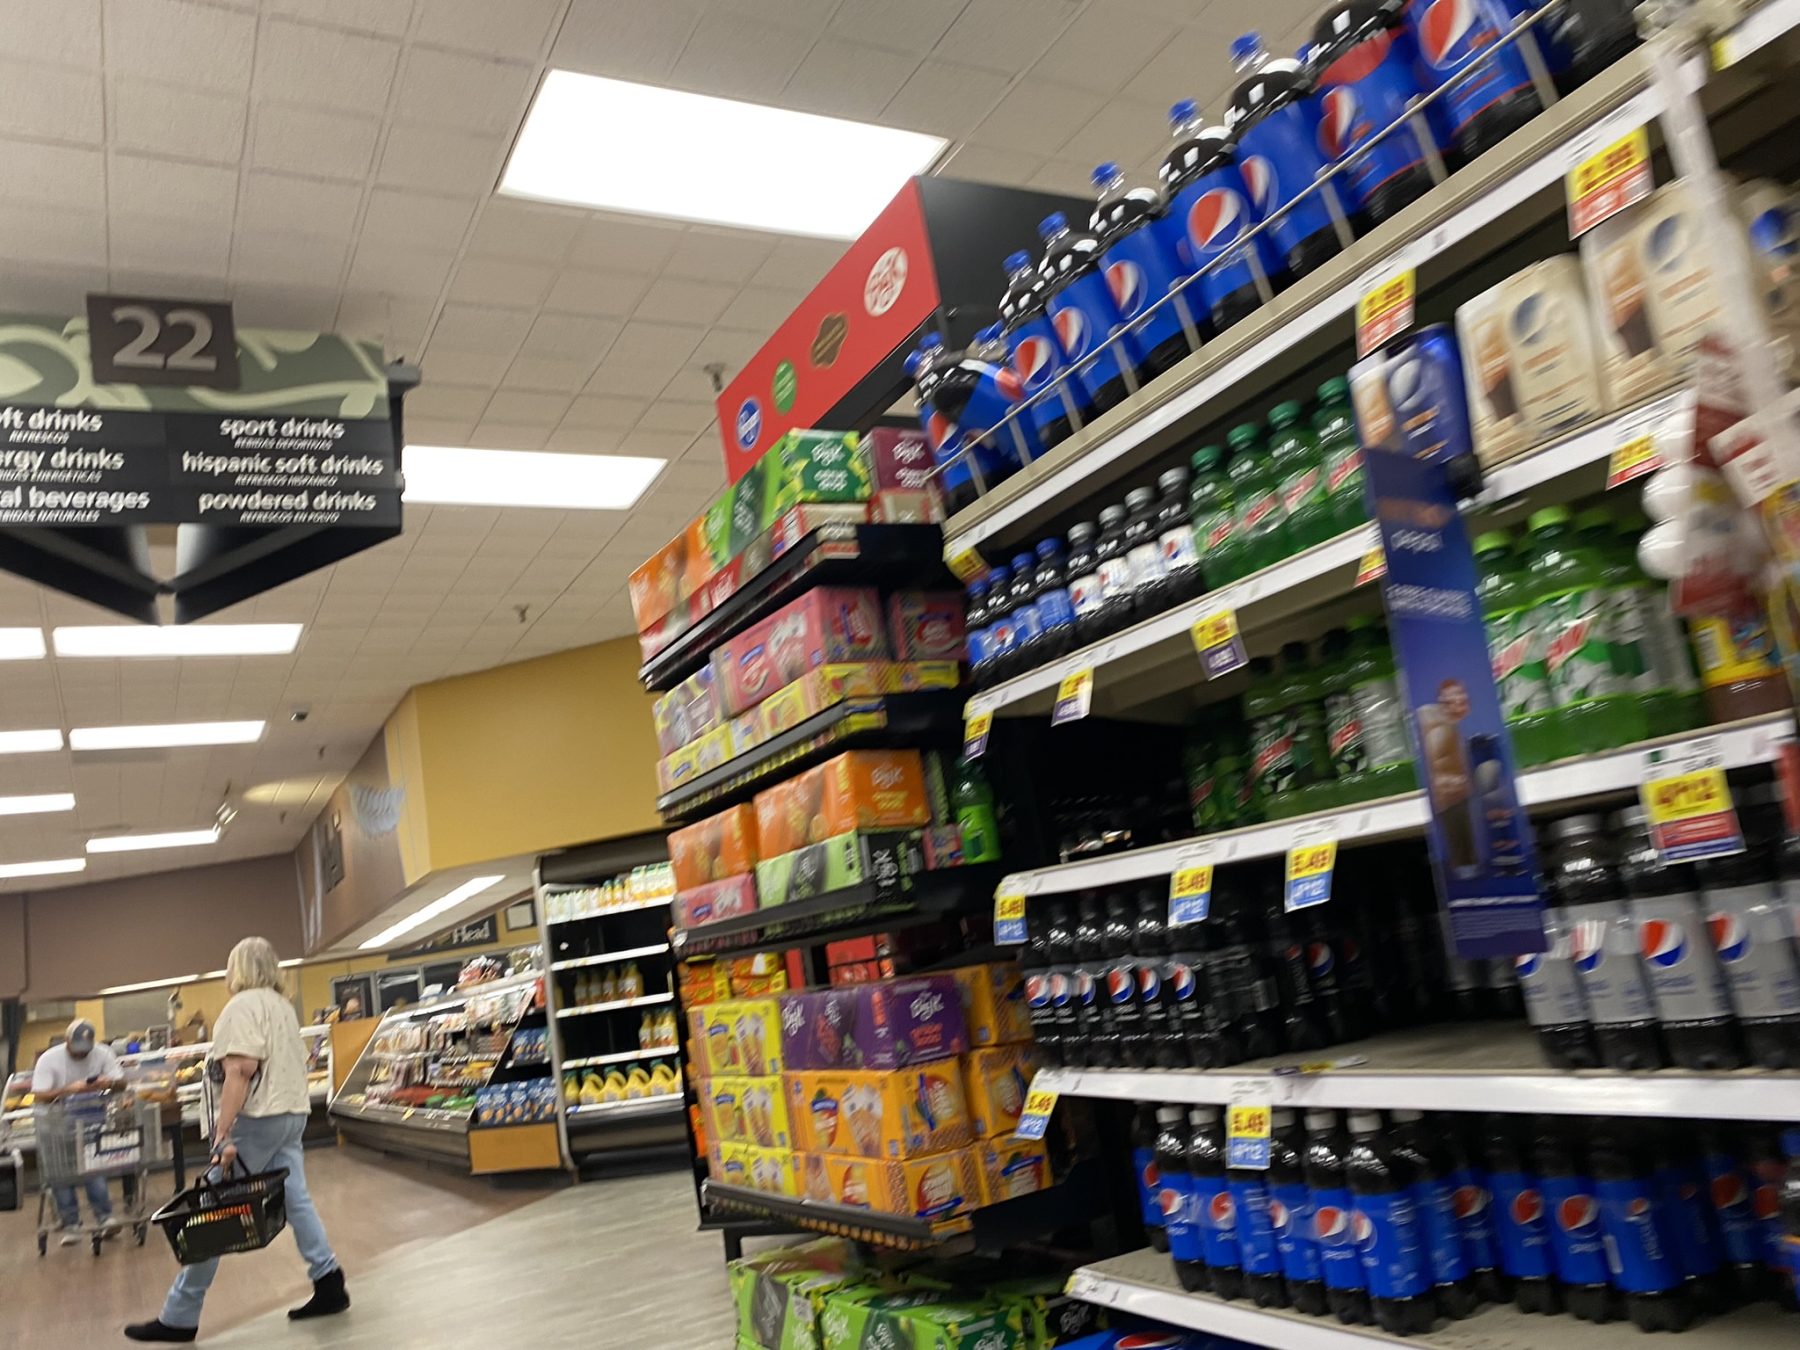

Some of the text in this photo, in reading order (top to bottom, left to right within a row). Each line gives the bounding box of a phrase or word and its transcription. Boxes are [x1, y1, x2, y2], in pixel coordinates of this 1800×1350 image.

[112, 305, 217, 372] 22
[0, 407, 103, 432] ft drinks
[219, 417, 346, 440] sport drinks
[9, 430, 70, 444] REFRESCOS
[50, 447, 125, 471] drinks
[182, 451, 384, 477] hispanic soft drinks
[0, 485, 151, 513] al beverages
[199, 489, 378, 515] powdered drinks
[37, 509, 101, 523] NATURALES
[452, 920, 491, 944] Head
